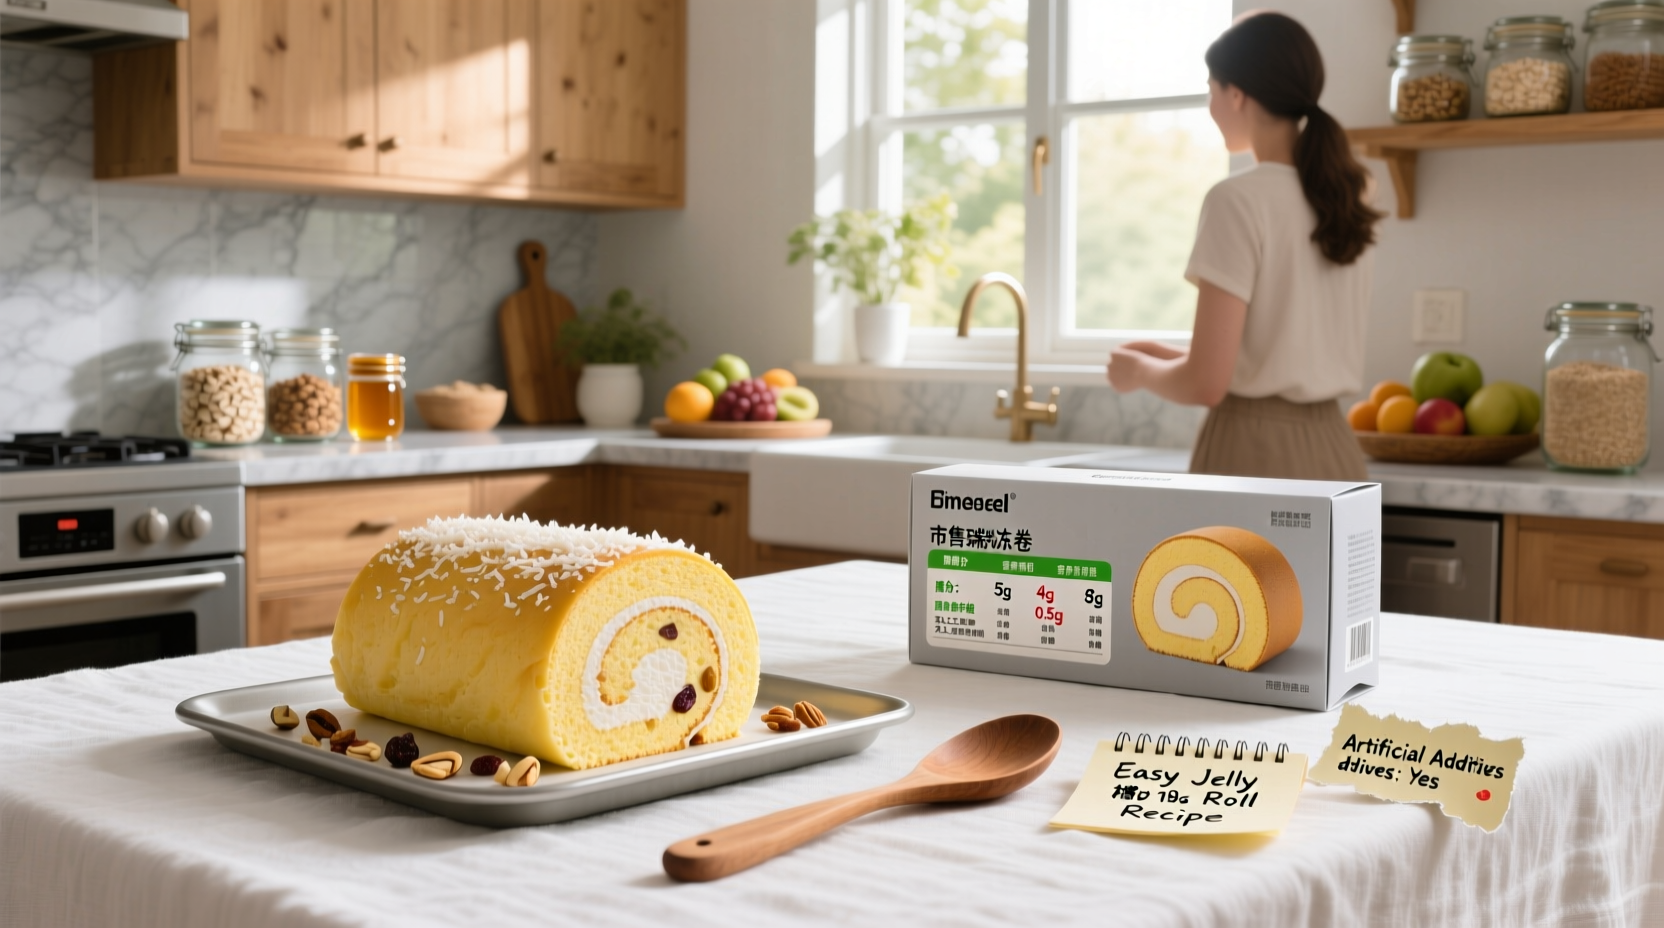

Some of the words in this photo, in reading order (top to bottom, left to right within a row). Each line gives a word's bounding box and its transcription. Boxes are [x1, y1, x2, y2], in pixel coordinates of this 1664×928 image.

[994, 582, 1012, 601] 5g
[1036, 585, 1055, 604] 4g
[1084, 588, 1103, 609] 8g
[1034, 606, 1064, 626] 0.5g
[1342, 733, 1426, 764] Artificial
[1113, 761, 1180, 788] Easy
[1190, 768, 1258, 794] Jelly
[1409, 766, 1440, 790] Yes
[1202, 791, 1259, 808] Roll
[1120, 804, 1223, 827] Recipe
